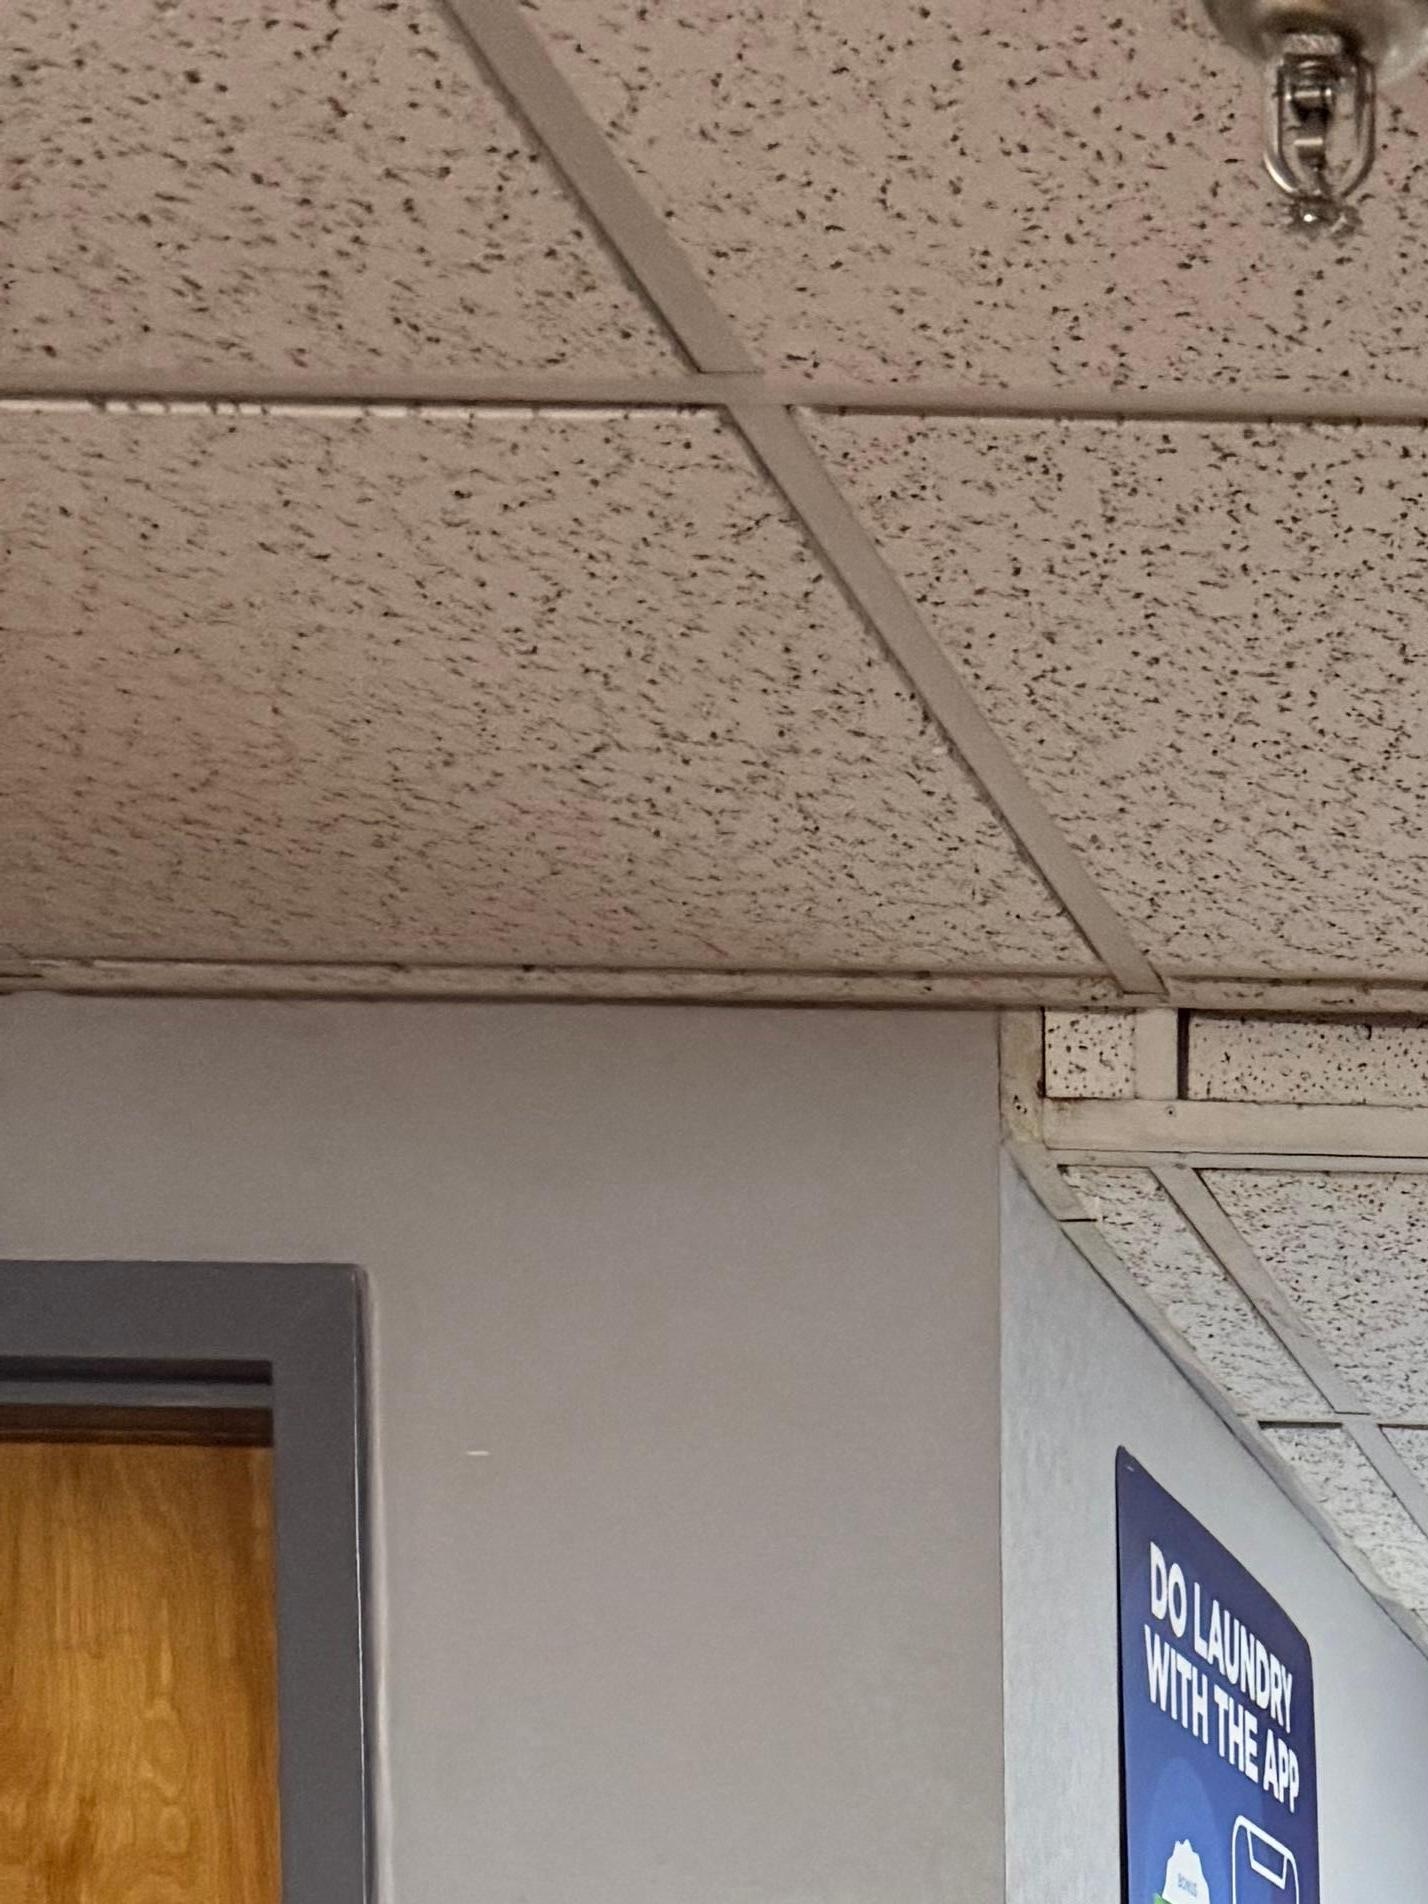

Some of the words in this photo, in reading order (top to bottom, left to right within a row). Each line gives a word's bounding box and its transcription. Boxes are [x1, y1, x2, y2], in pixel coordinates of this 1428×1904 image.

[1144, 1624, 1209, 1745] WITH
[1214, 1685, 1258, 1785] THE
[1263, 1728, 1299, 1814] APP
[1150, 1541, 1187, 1638] DO
[1193, 1582, 1293, 1733] LAUNDRY
